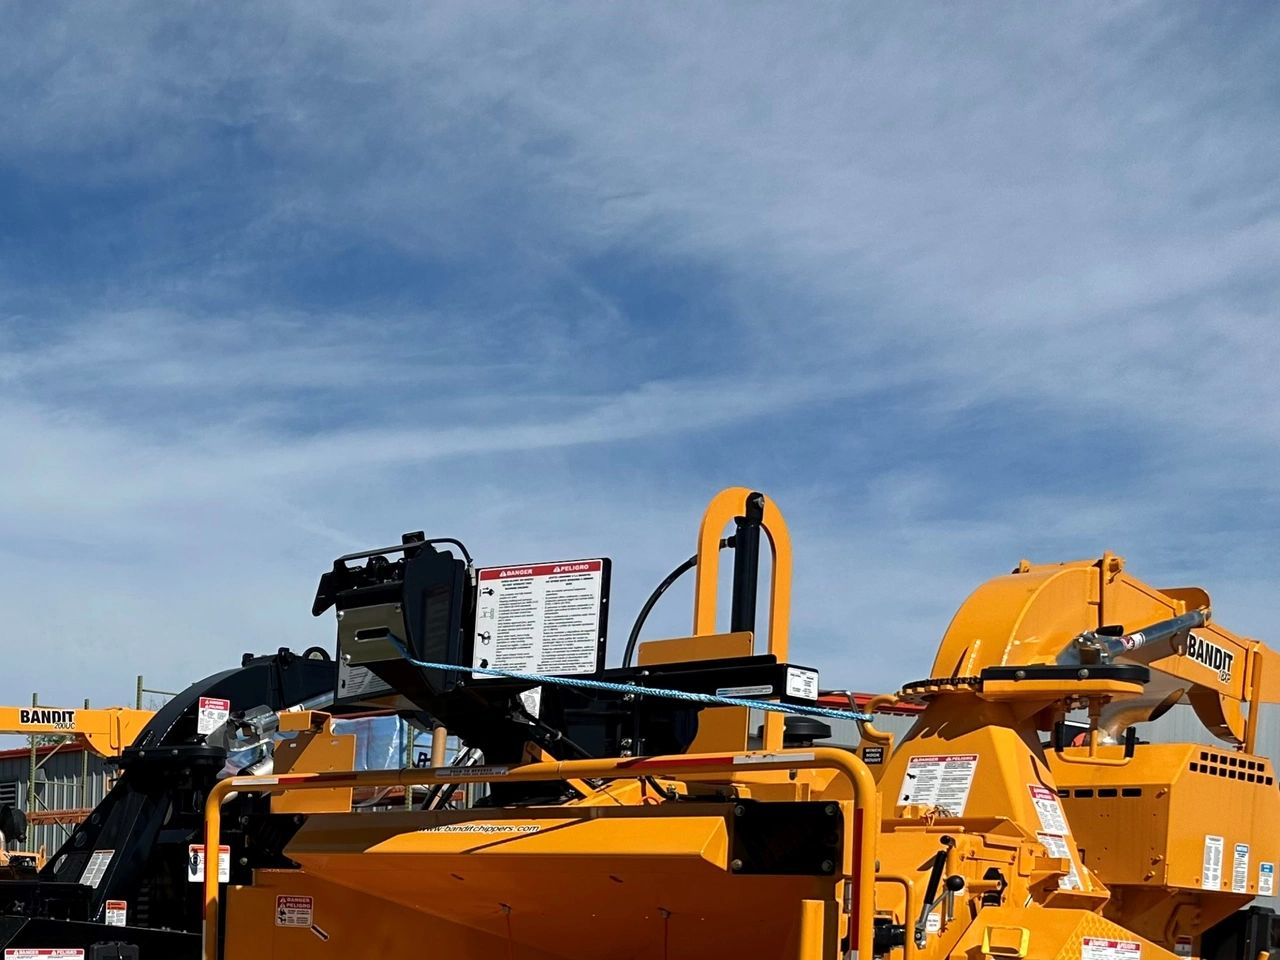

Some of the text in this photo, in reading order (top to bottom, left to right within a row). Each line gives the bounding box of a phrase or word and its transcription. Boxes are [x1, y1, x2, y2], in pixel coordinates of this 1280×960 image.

[506, 564, 589, 577] DANGER PELIGRO
[1187, 633, 1234, 673] BANDIT
[20, 709, 75, 724] BANDIT
